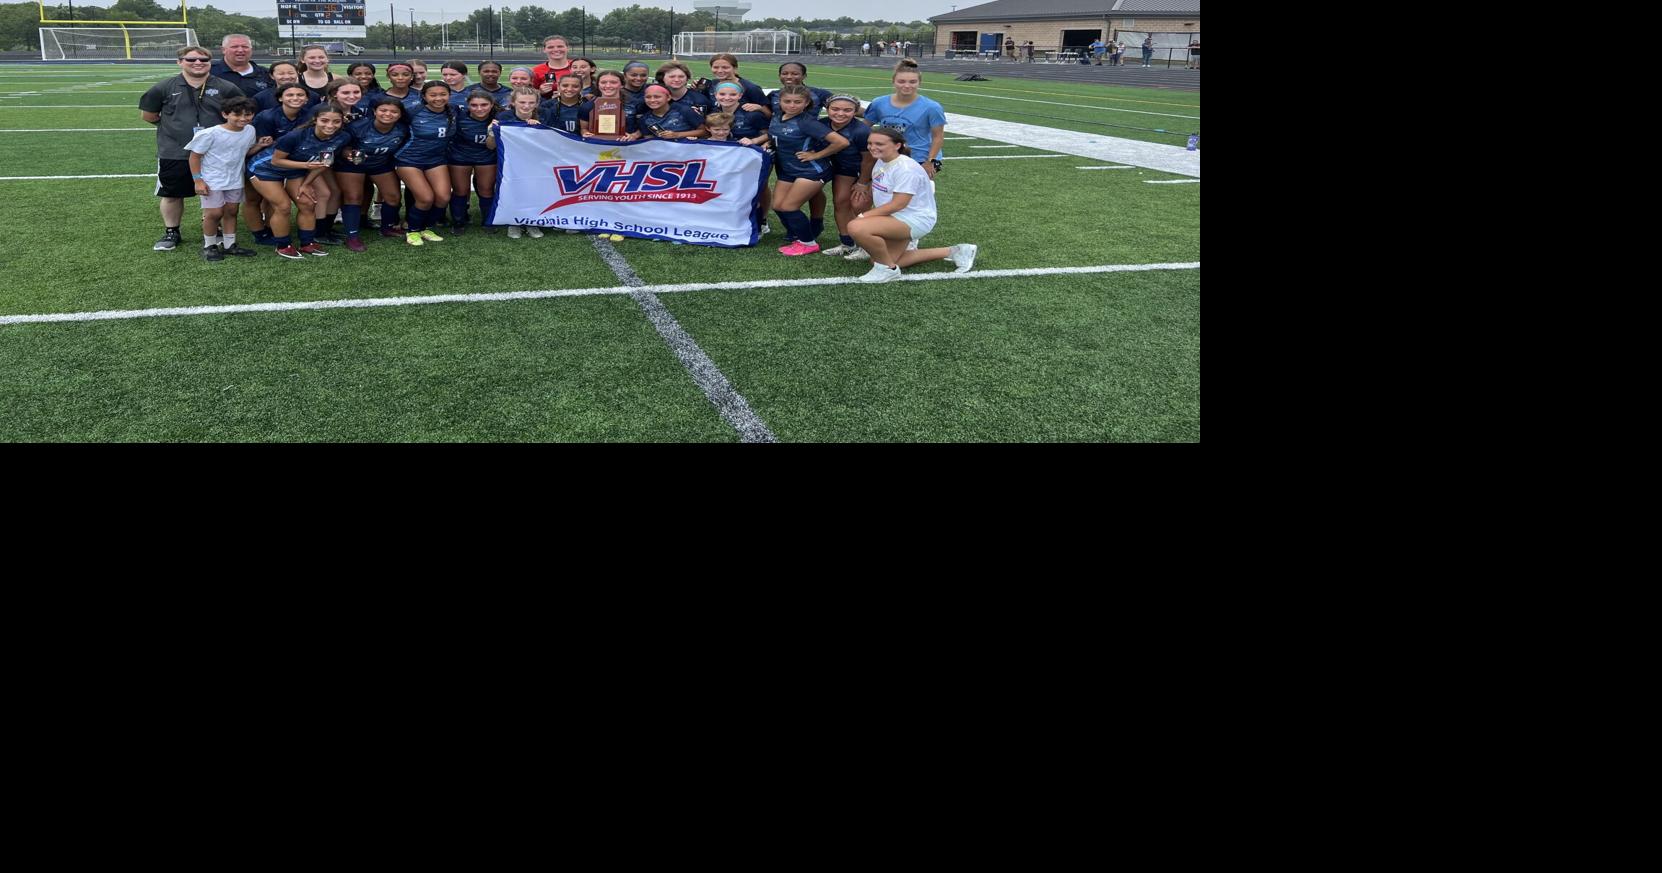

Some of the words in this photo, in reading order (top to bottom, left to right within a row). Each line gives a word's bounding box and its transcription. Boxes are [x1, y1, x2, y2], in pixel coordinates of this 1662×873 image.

[565, 120, 576, 132] 10
[438, 127, 447, 138] 8
[474, 134, 487, 144] 12
[554, 159, 717, 195] VHSL
[614, 193, 646, 201] YOUTH
[647, 192, 673, 200] SINCE
[574, 216, 609, 228] High
[614, 221, 668, 235] School
[674, 227, 729, 240] League
